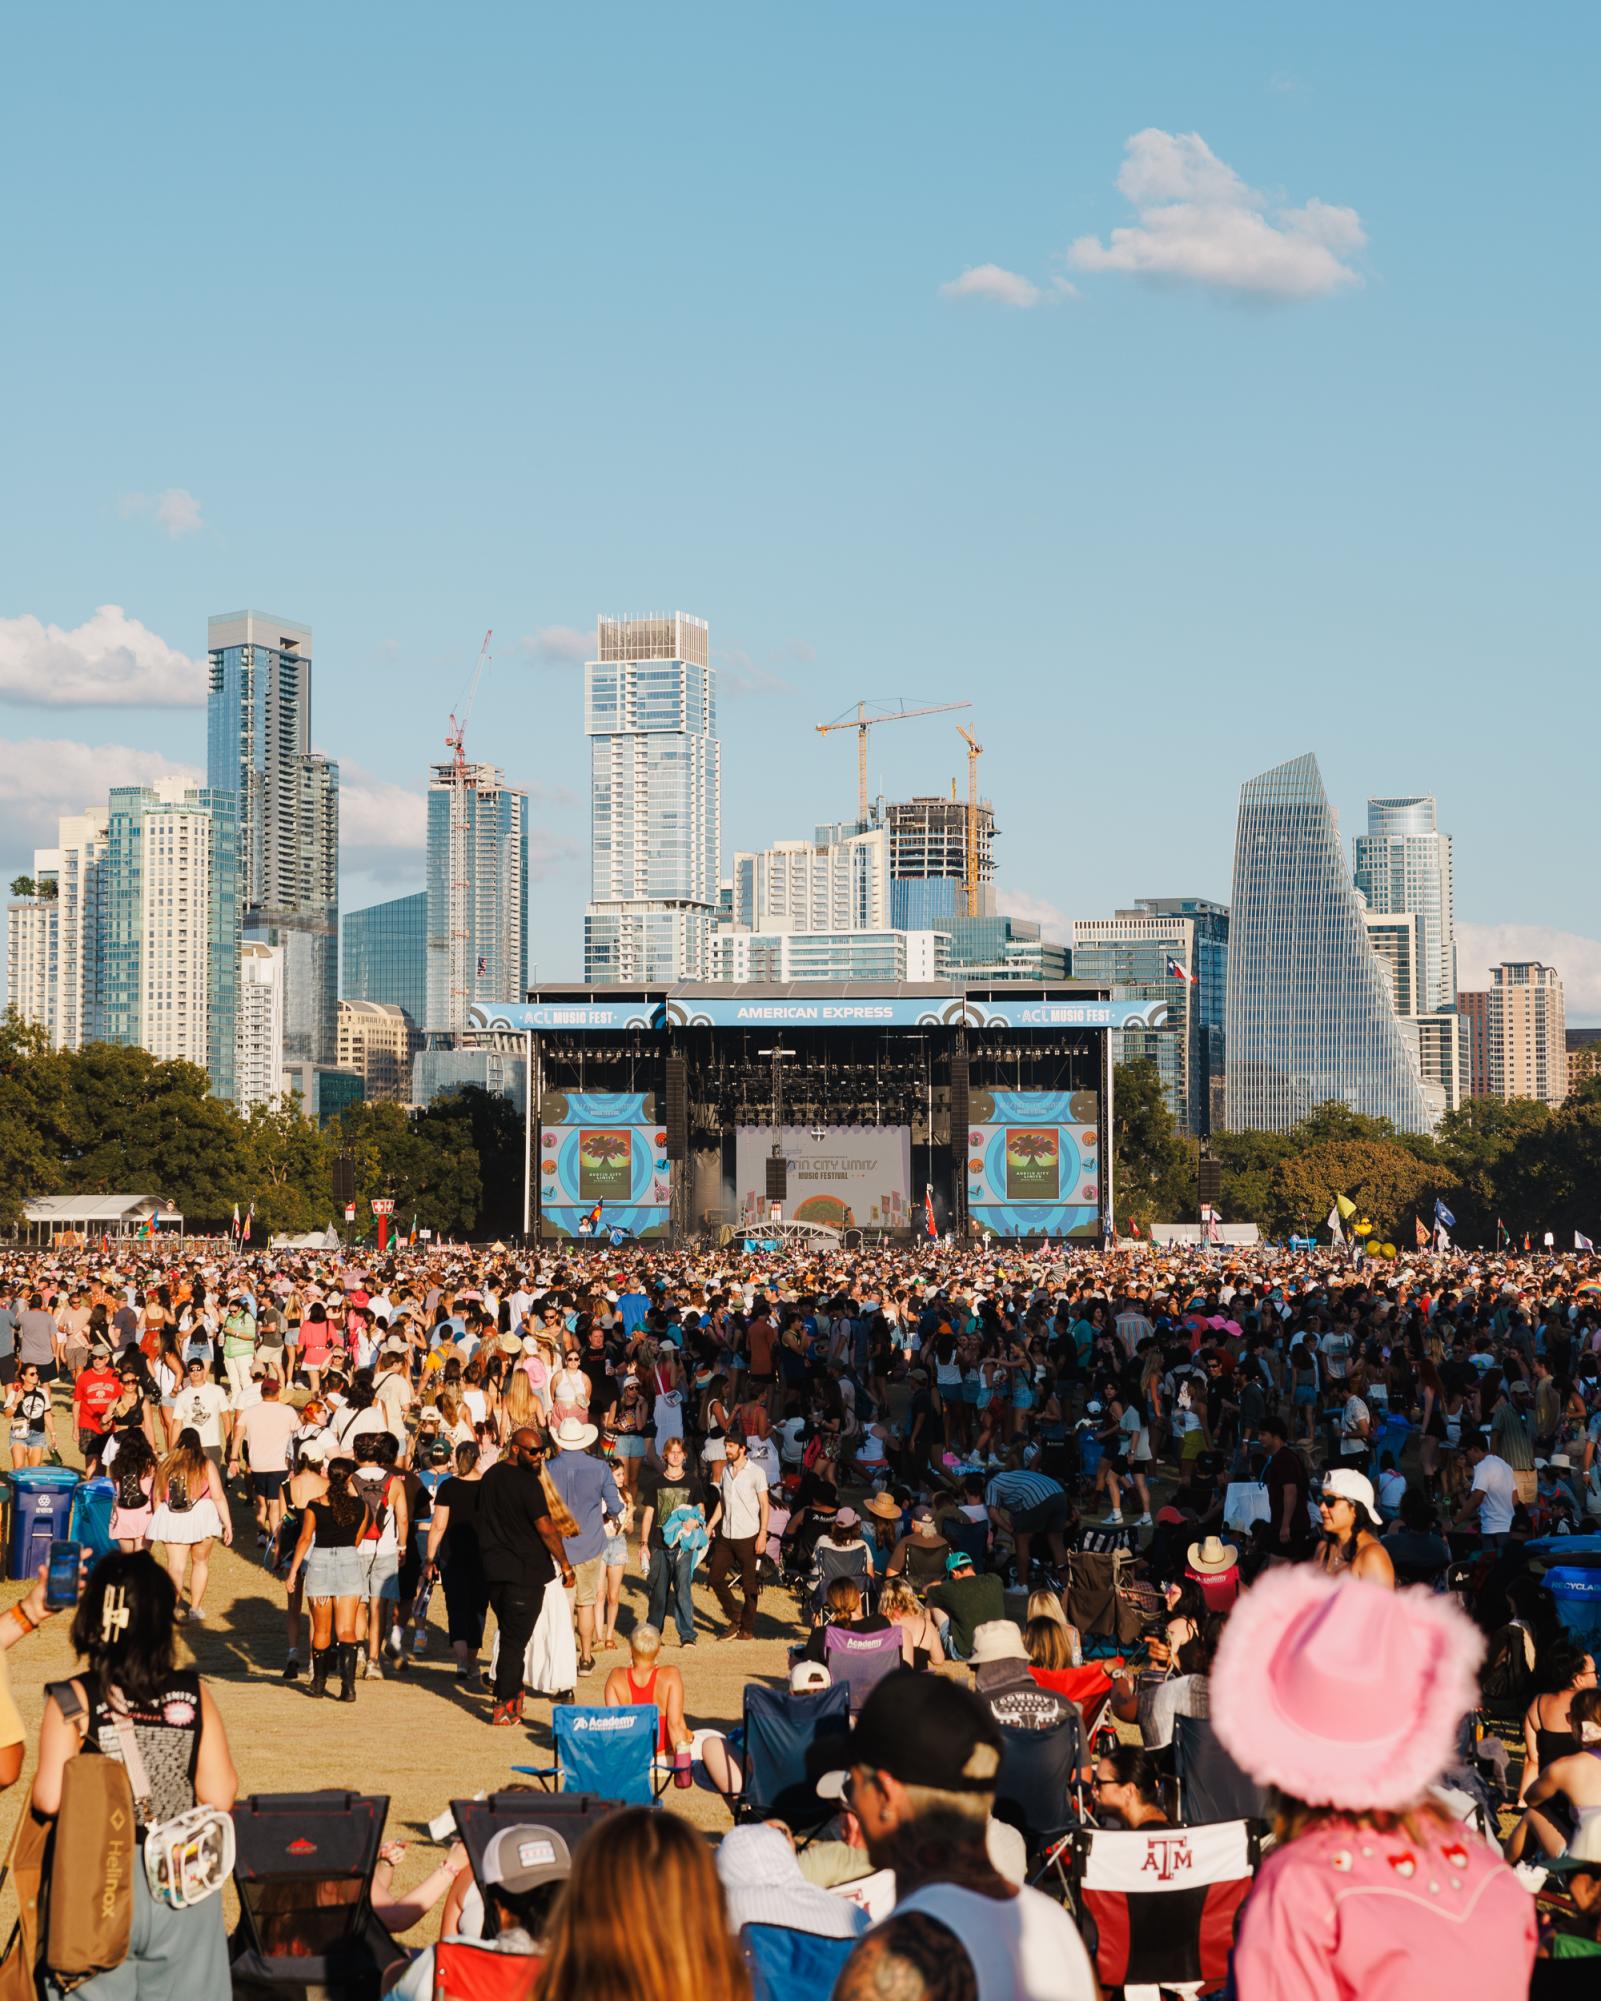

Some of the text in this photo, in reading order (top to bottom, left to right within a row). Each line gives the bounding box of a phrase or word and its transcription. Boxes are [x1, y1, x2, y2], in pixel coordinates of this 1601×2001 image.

[523, 1011, 613, 1024] ACL MUSIC FEST
[737, 1007, 894, 1018] AMERICAN EXPRESS
[1022, 1009, 1111, 1022] ACL MUSIC FEST
[813, 1160, 838, 1170] CITY
[798, 1171, 848, 1180] MUSIC FESTIVAL
[847, 1637, 884, 1649] Academy
[1000, 1693, 1050, 1704] COWBOY
[588, 1715, 638, 1729] Academy
[101, 1840, 125, 1918] Helinox
